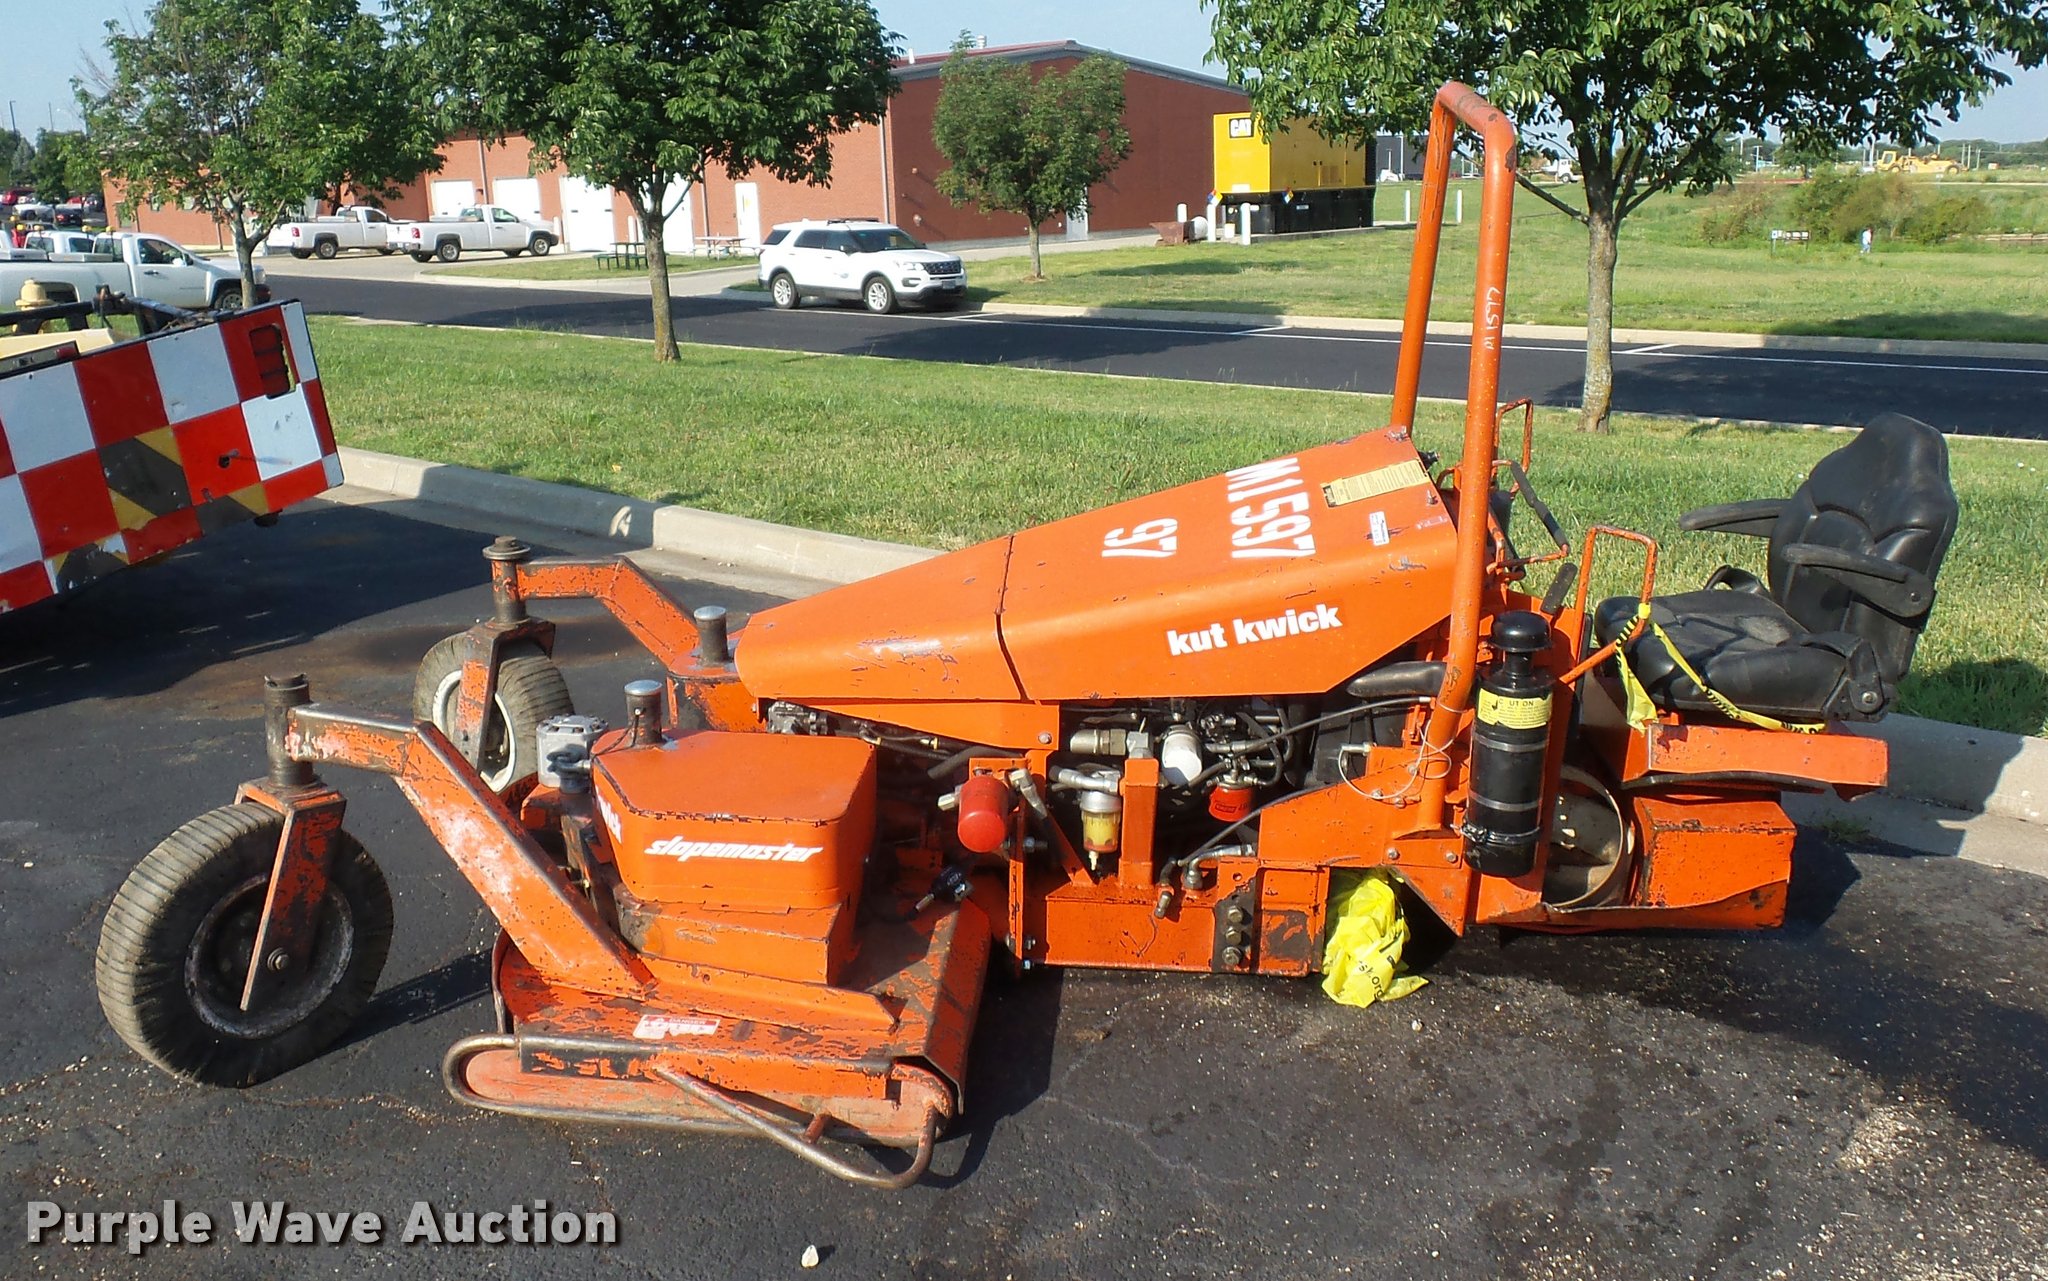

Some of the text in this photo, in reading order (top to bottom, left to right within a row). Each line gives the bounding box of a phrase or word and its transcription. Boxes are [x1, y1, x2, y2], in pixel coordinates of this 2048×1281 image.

[1230, 118, 1253, 138] CAT
[1225, 457, 1316, 559] M1597
[1101, 518, 1178, 558] 97
[1167, 604, 1343, 656] kut kwick
[644, 836, 824, 863] slopemaster
